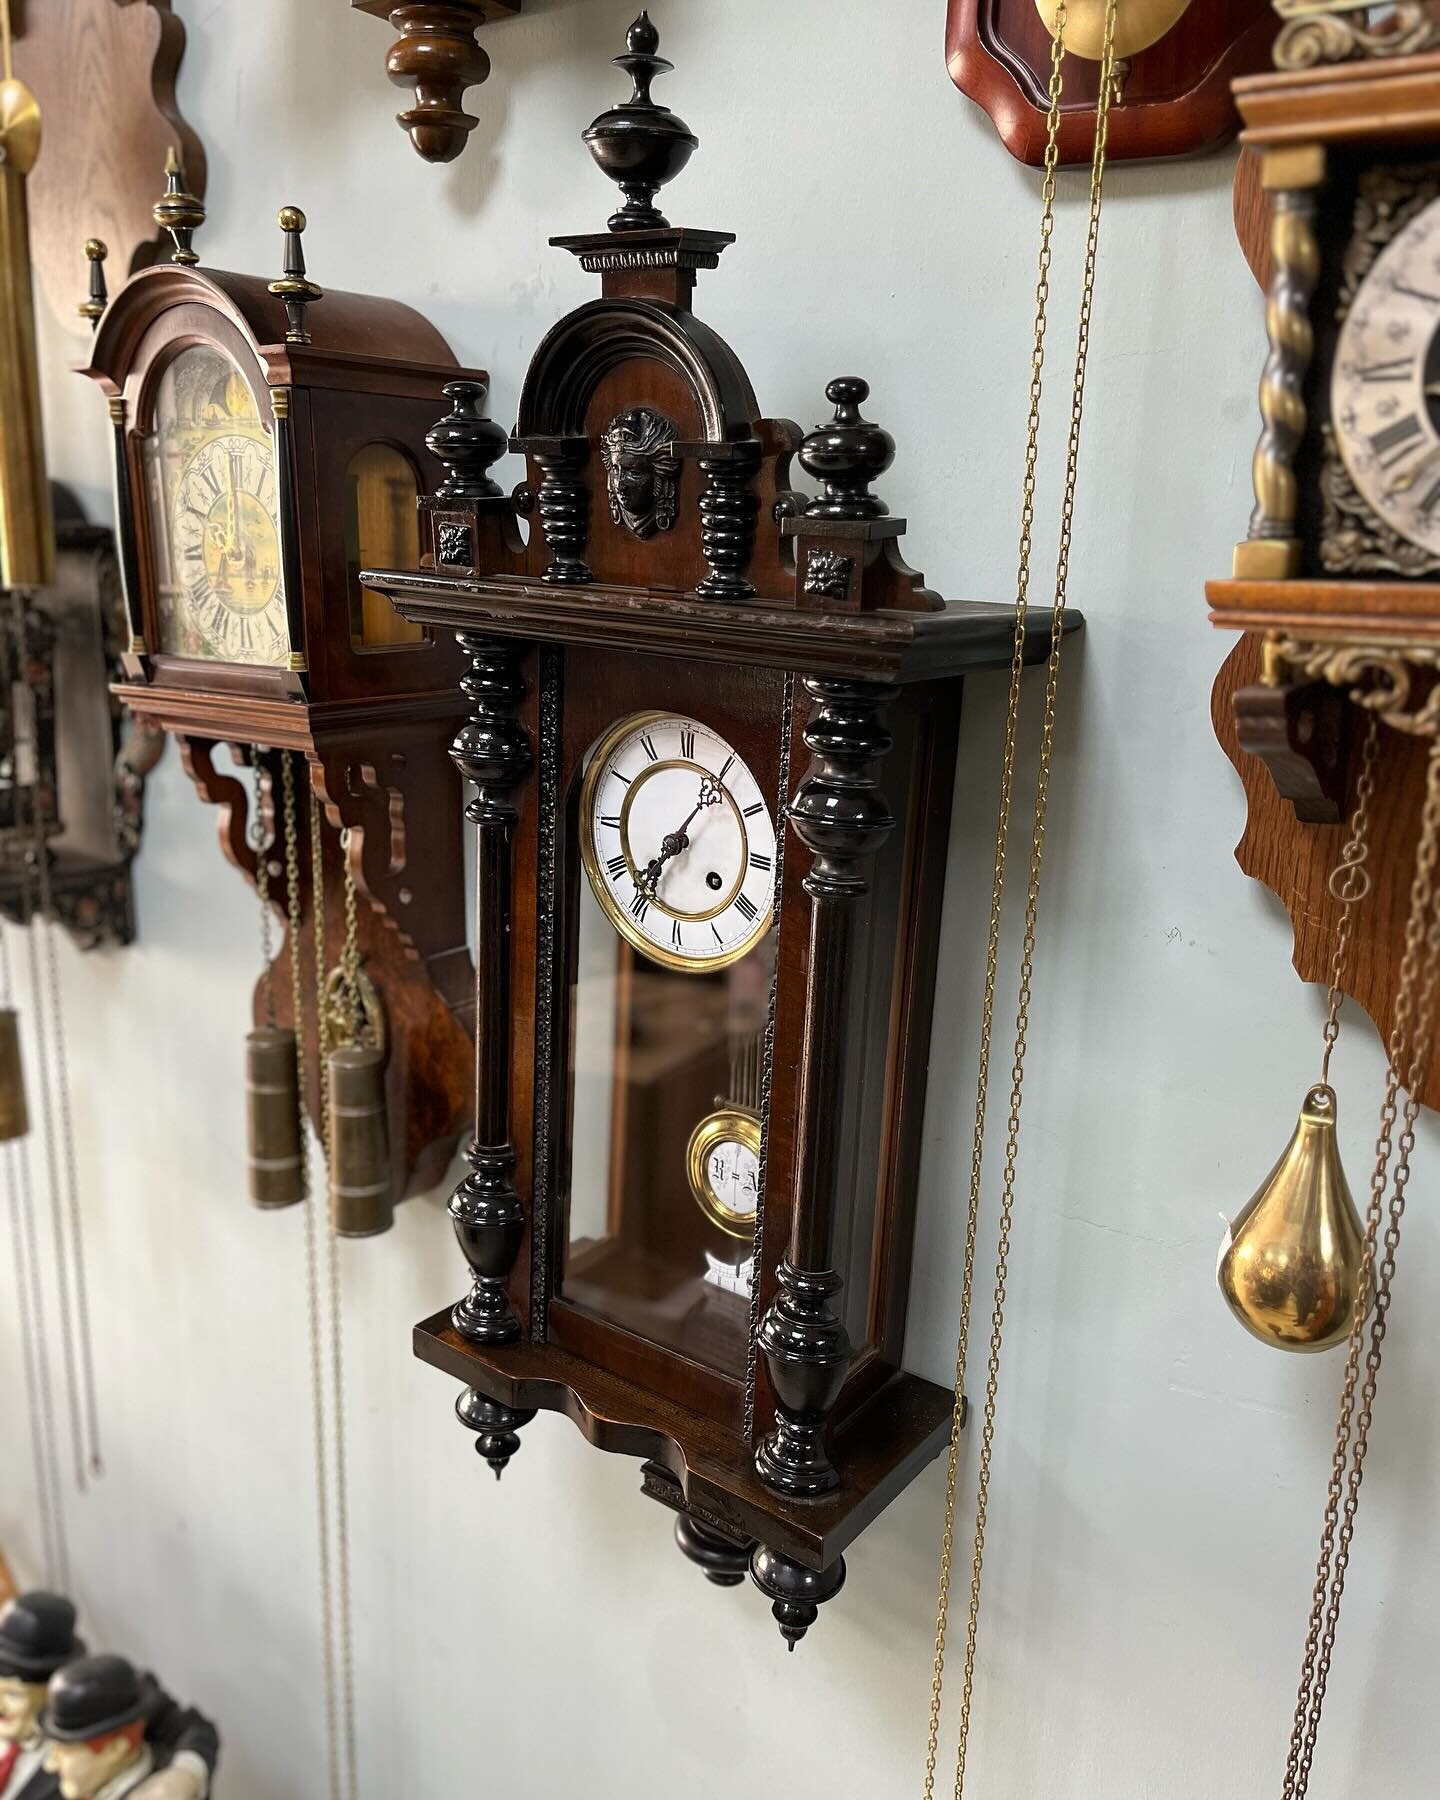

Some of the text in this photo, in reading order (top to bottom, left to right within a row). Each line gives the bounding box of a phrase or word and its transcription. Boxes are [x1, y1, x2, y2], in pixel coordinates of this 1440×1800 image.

[640, 735, 658, 764] XI
[680, 731, 695, 759] XII
[600, 811, 620, 829] IX
[743, 802, 763, 818] II
[606, 854, 627, 882] VIII
[750, 852, 771, 871] III
[734, 892, 758, 922] IIII
[672, 919, 683, 946] VI
[711, 921, 723, 946] V
